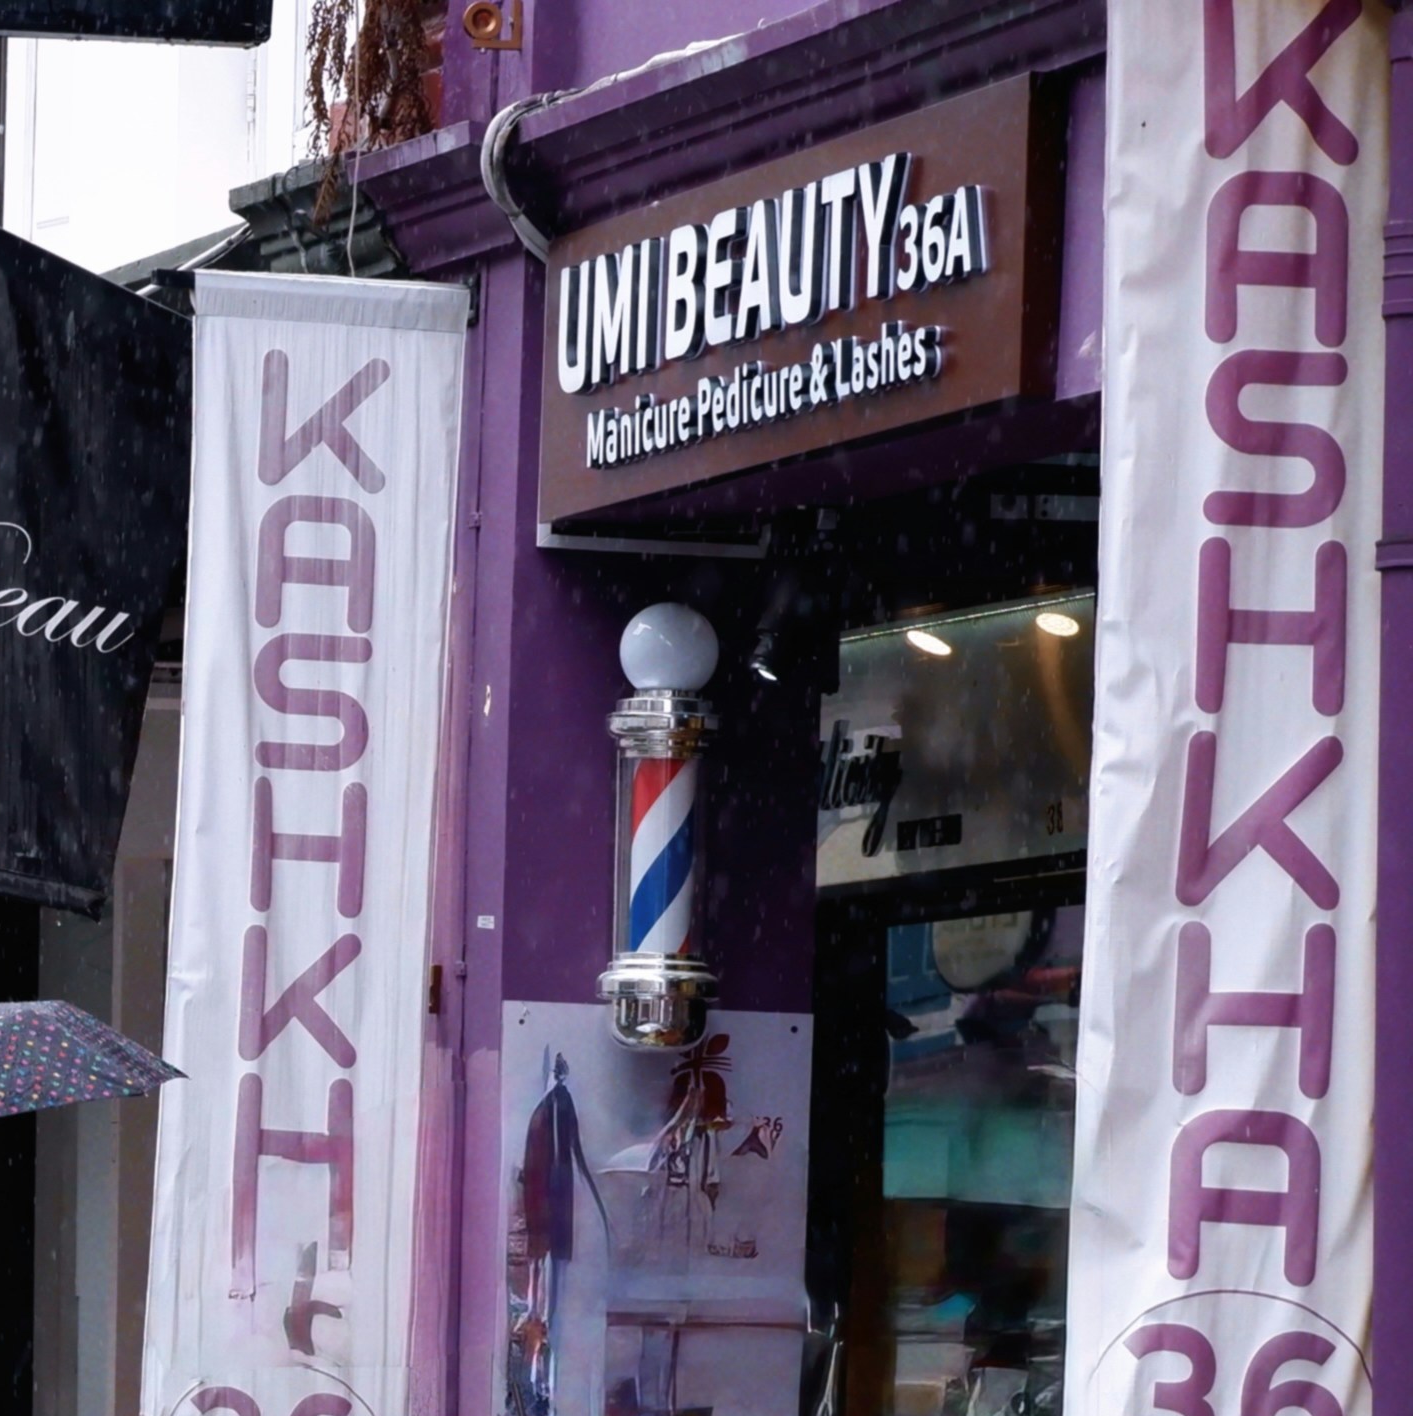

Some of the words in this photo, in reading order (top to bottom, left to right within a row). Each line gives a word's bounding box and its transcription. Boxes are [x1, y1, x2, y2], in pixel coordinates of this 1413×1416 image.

[558, 237, 663, 394] UMI
[665, 152, 911, 360] BEAUTY
[897, 184, 987, 293] 36A
[586, 393, 693, 468] Manicure
[697, 361, 805, 437] Pedicure
[809, 342, 837, 404] &
[834, 321, 942, 395] Lashes
[232, 348, 389, 1355] KASHKH
[1165, 0, 1363, 1288] KASHKHA
